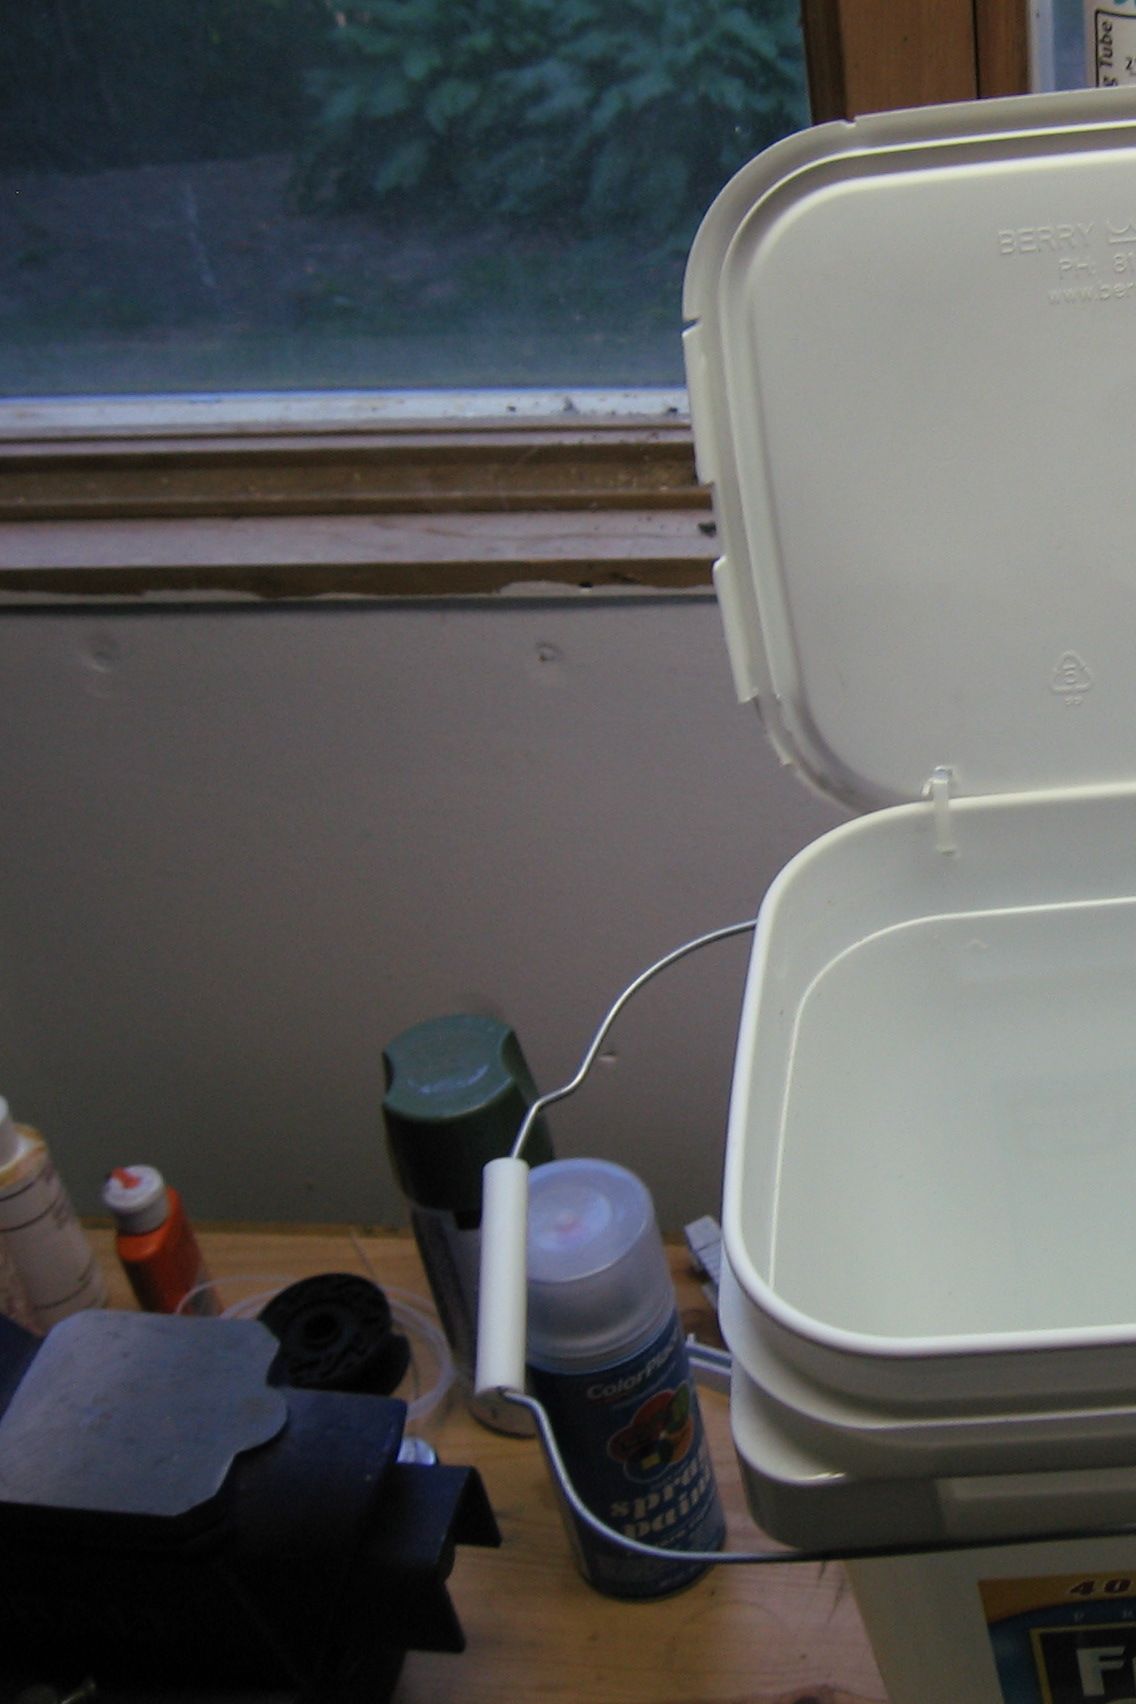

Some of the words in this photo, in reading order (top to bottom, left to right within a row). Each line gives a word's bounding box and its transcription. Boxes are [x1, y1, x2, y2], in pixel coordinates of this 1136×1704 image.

[1100, 21, 1113, 67] Tube
[998, 222, 1096, 256] BERRY
[1067, 1577, 1133, 1597] 40
